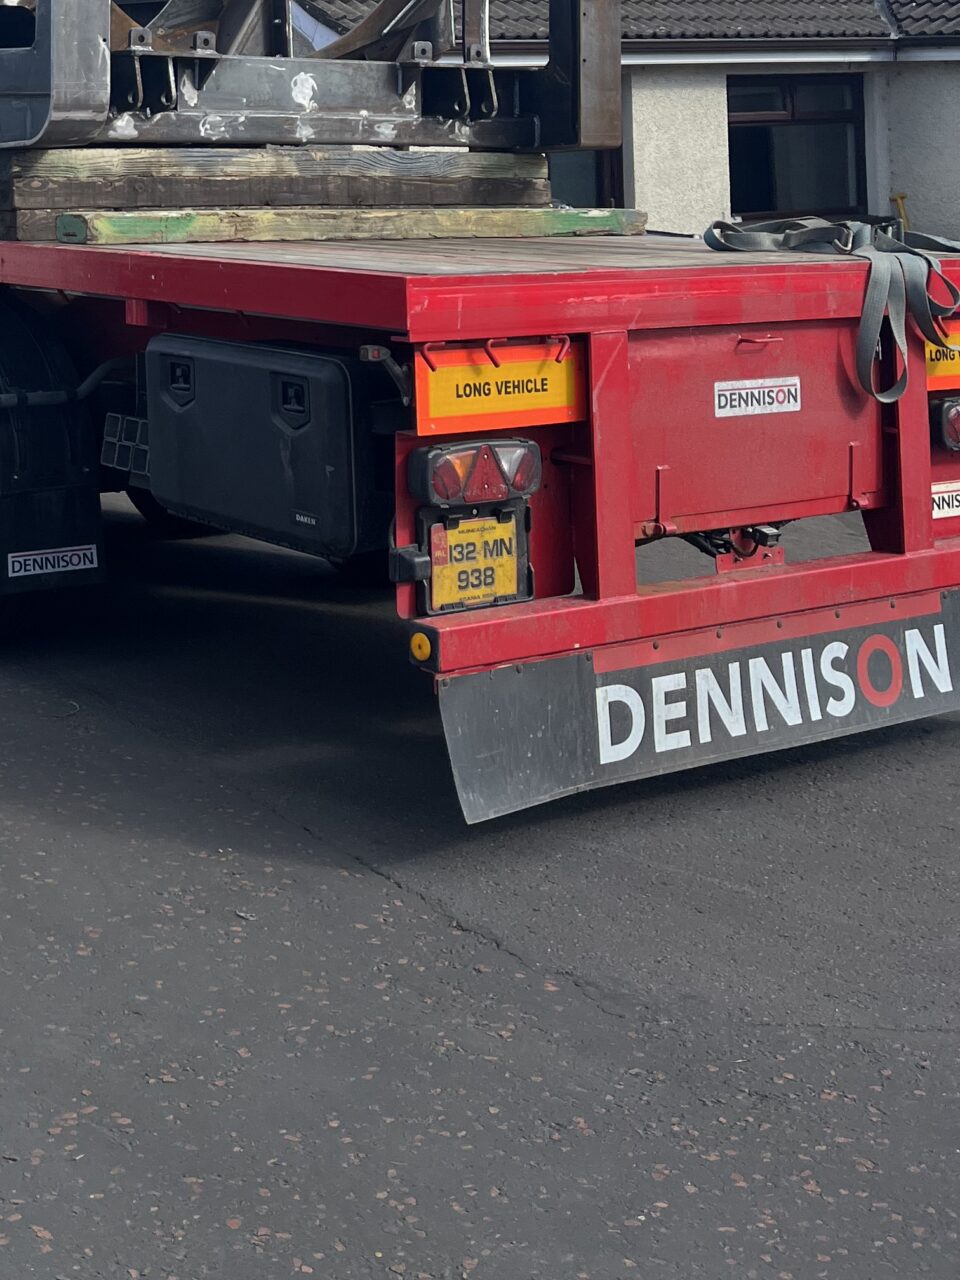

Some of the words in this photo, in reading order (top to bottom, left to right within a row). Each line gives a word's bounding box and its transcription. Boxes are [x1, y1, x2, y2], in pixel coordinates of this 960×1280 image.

[930, 348, 956, 362] LONG
[455, 381, 492, 399] LONG
[495, 377, 549, 396] VEHICLE
[717, 387, 798, 410] DENNISON
[448, 541, 478, 563] 132
[483, 536, 513, 559] MN
[11, 551, 95, 574] DENNISON
[457, 565, 496, 590] 938
[595, 623, 953, 765] DENNISON
